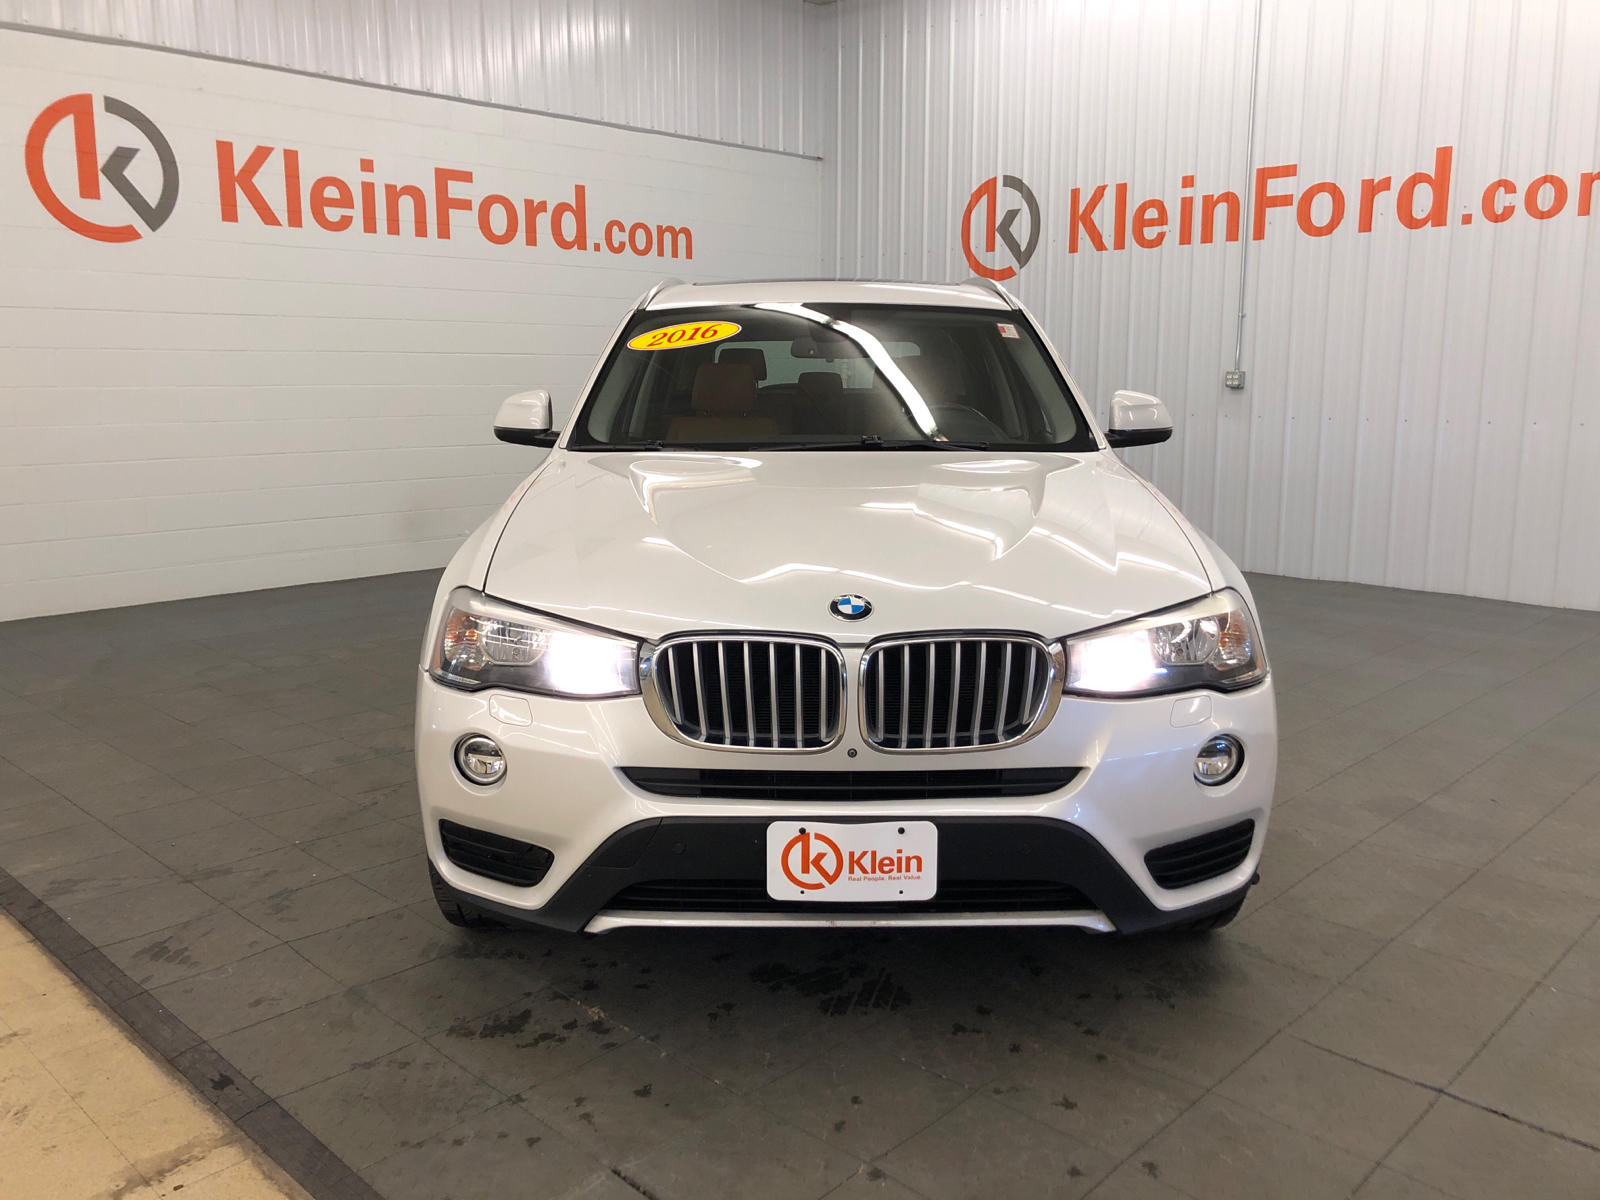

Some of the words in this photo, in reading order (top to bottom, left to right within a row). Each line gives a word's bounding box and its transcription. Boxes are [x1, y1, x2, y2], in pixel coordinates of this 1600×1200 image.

[216, 139, 693, 260] KleinFord.com
[646, 323, 722, 347] 2016
[848, 849, 923, 875] Klein
